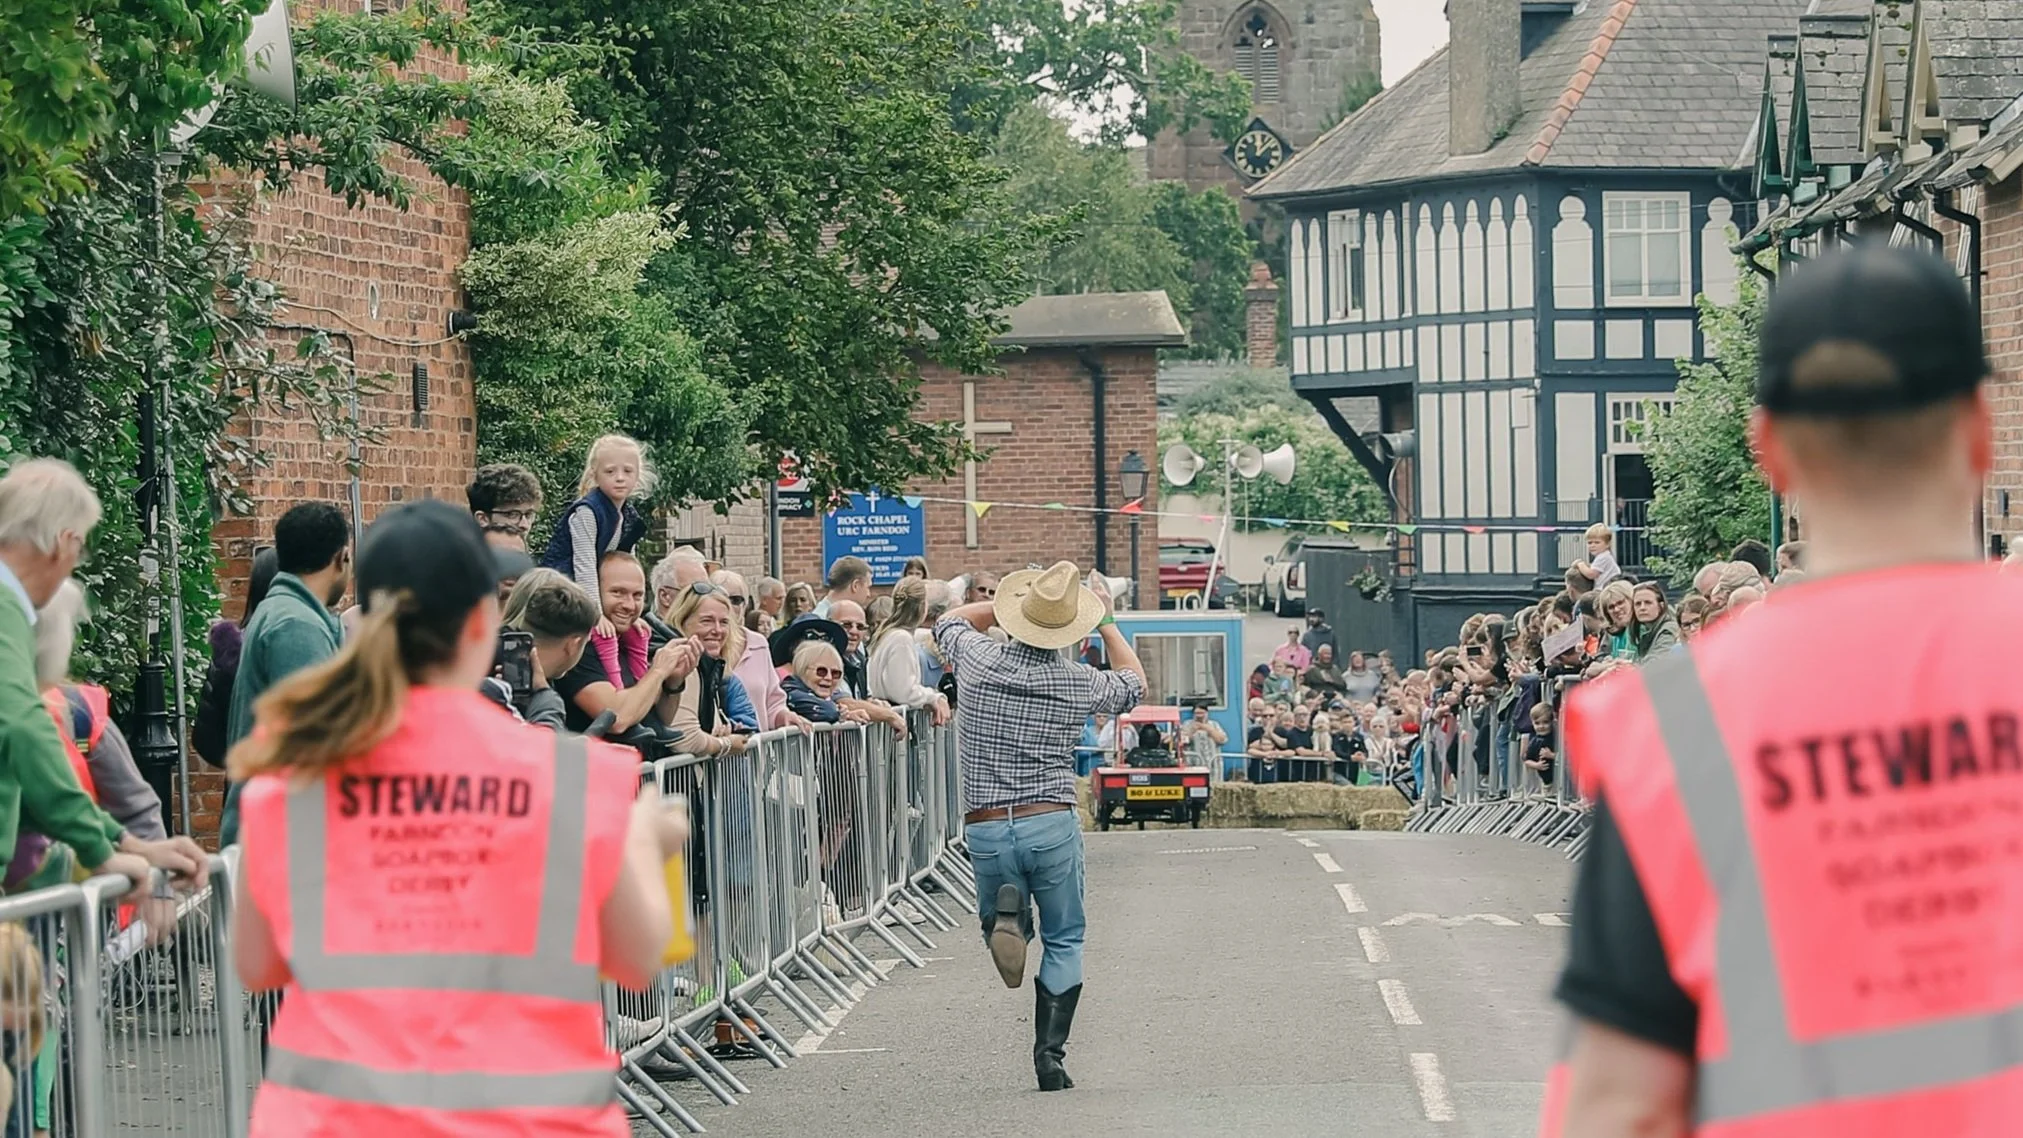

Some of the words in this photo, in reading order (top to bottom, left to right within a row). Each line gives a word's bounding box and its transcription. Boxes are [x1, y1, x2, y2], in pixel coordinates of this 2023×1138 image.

[837, 516, 867, 525] ROCK
[867, 515, 910, 525] CHAPEL
[837, 527, 860, 536] URC
[862, 526, 910, 535] FARNDON
[339, 773, 531, 820] STEWARD
[1130, 789, 1143, 797] BO
